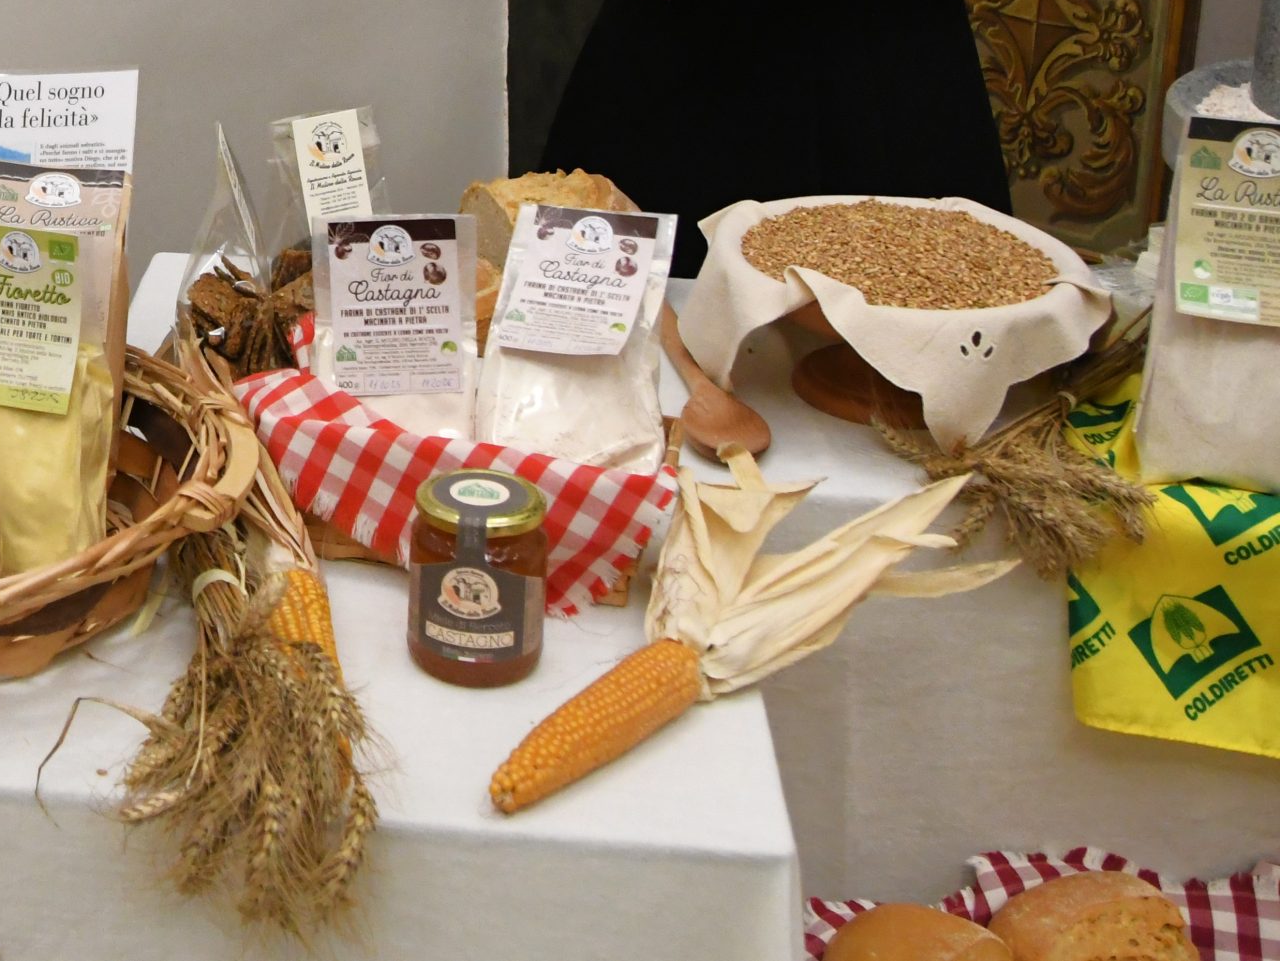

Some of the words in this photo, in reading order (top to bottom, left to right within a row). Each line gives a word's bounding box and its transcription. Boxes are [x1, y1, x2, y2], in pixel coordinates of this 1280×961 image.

[47, 84, 105, 106] sogno
[20, 106, 99, 129] felicità»
[1196, 176, 1230, 202] La
[1234, 180, 1280, 206] Rust
[30, 209, 104, 227] Rustica
[400, 269, 414, 281] di
[539, 260, 628, 289] Castagna
[348, 280, 441, 307] Castagna
[1184, 653, 1274, 721] COLDIRETTI
